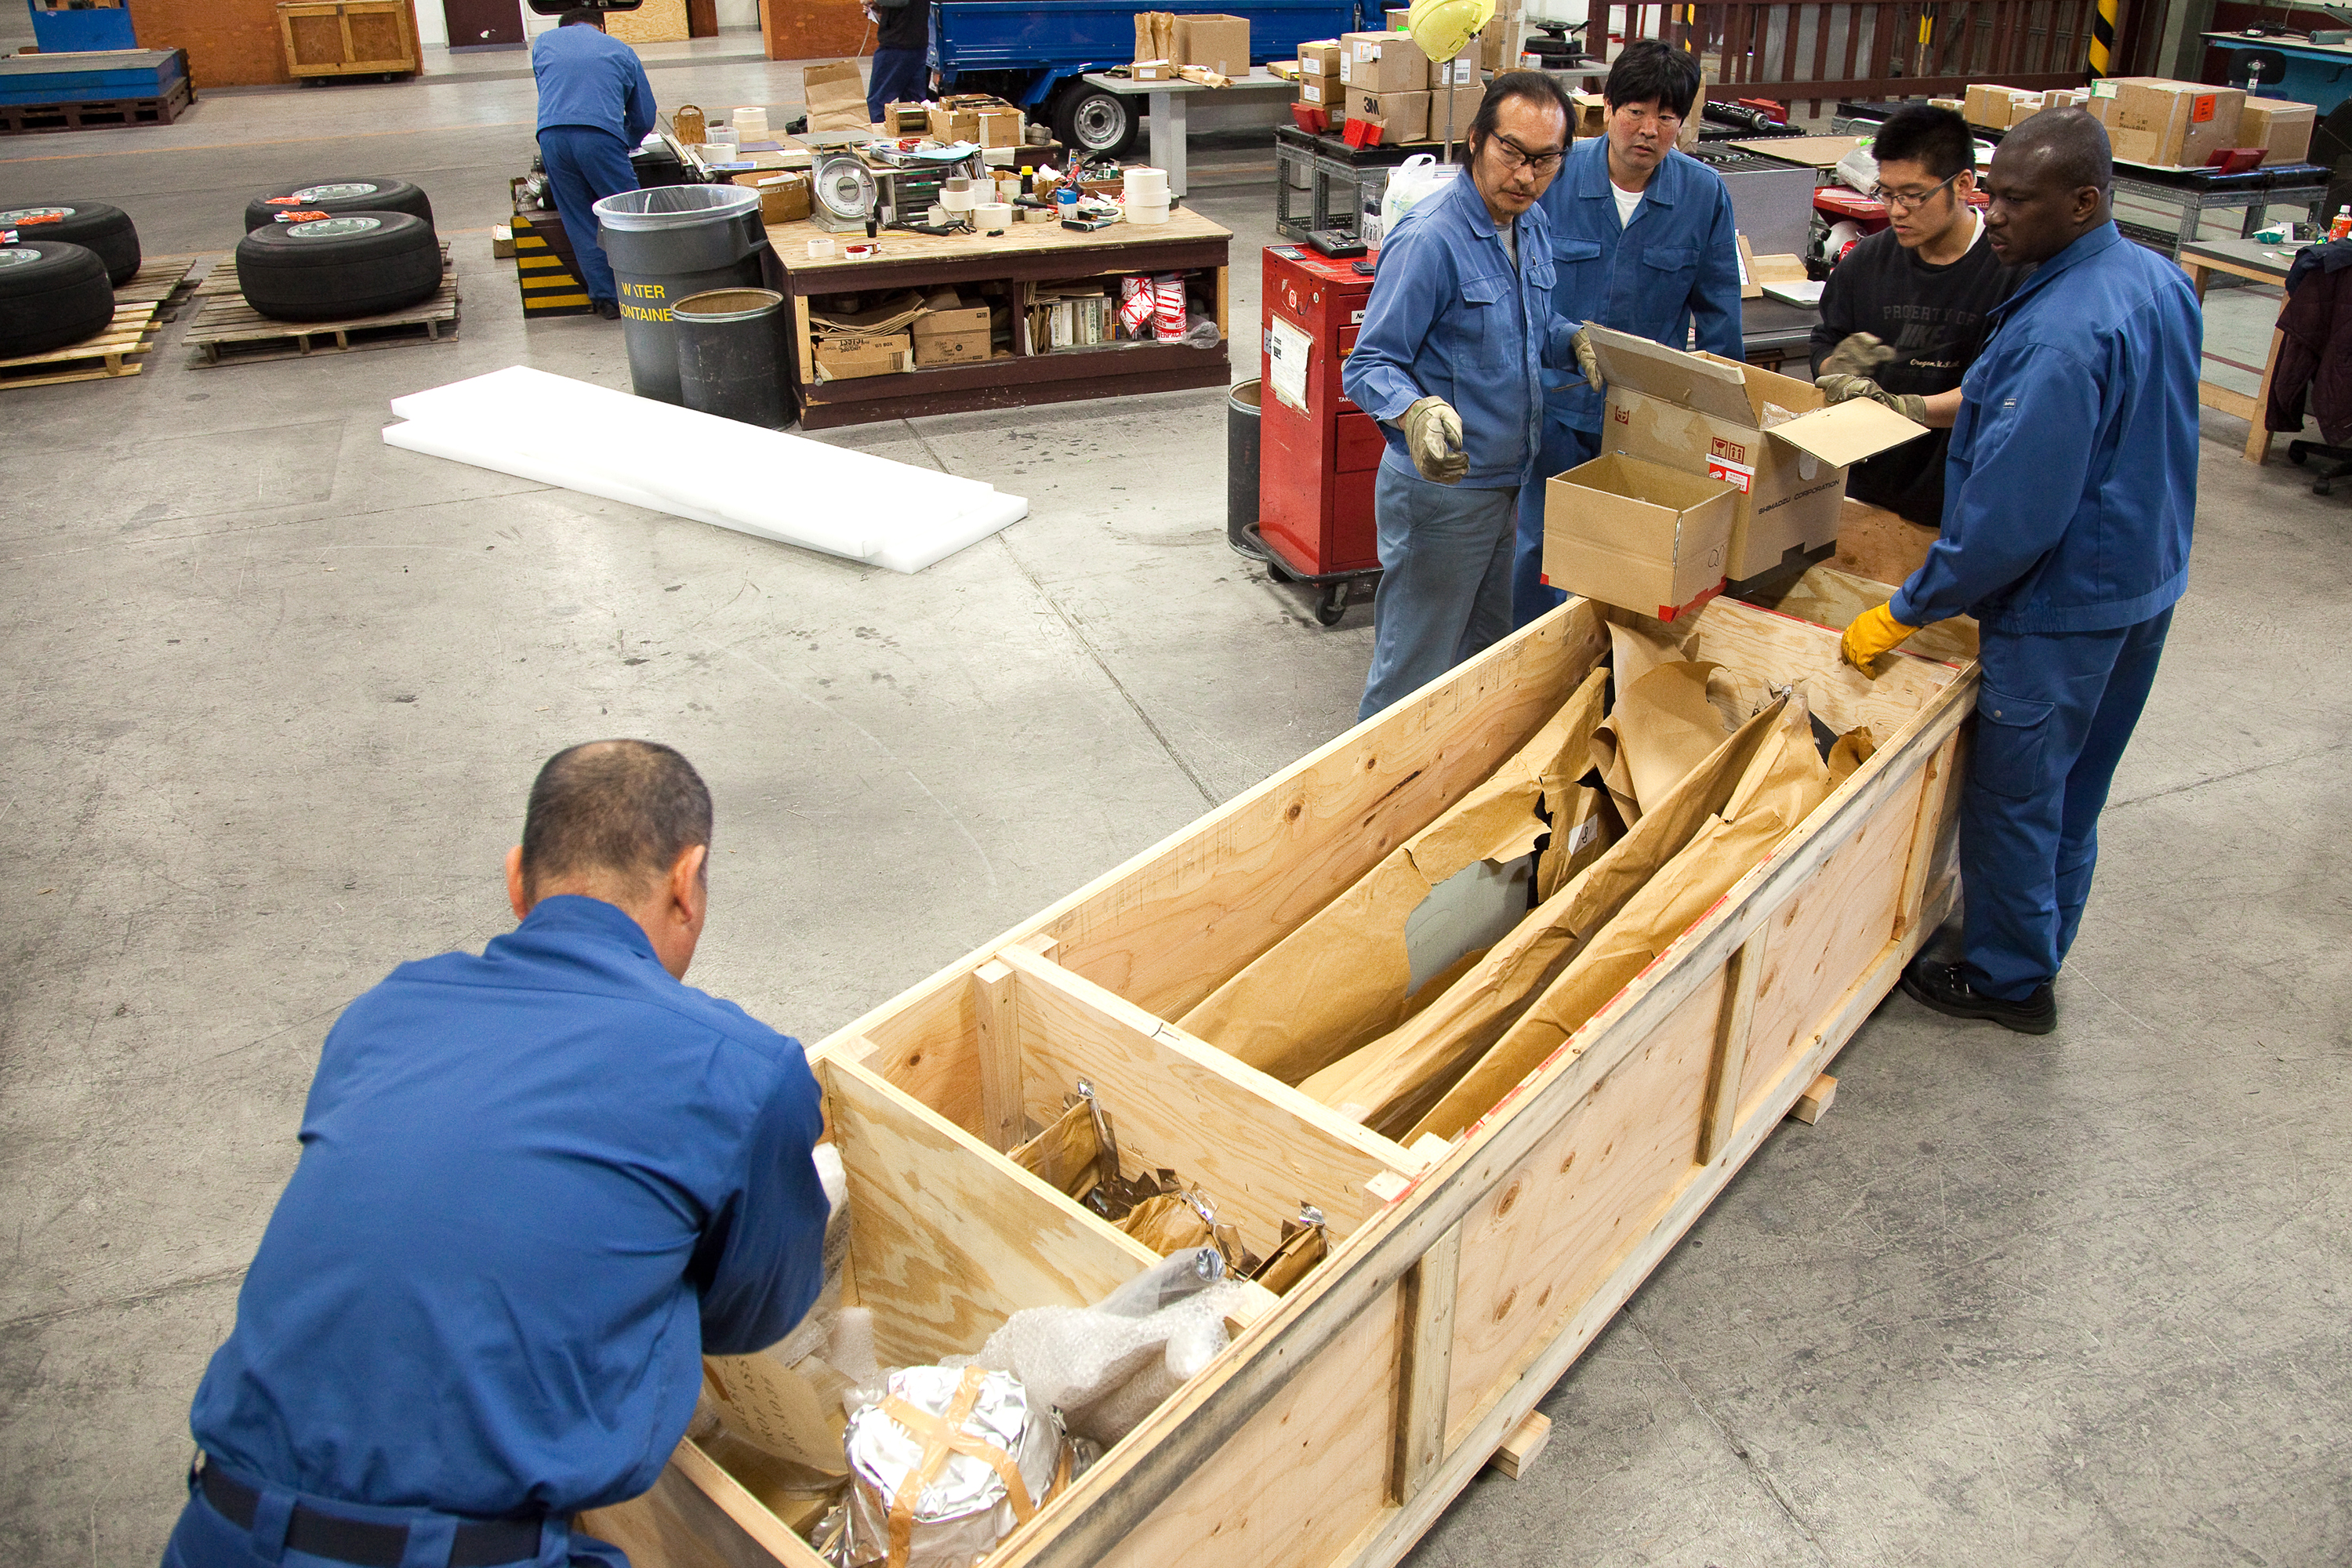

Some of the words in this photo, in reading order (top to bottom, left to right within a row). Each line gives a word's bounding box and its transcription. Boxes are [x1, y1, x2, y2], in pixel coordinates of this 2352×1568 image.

[1364, 96, 1380, 115] 3M
[619, 302, 673, 322] CONTAINE
[1133, 297, 1149, 314] FRAGILE
[1883, 305, 1953, 321] PROERTY
[1894, 323, 1946, 350] NIKE
[1759, 496, 1791, 515] SHIMADZU
[1794, 478, 1840, 501] CORPORATION
